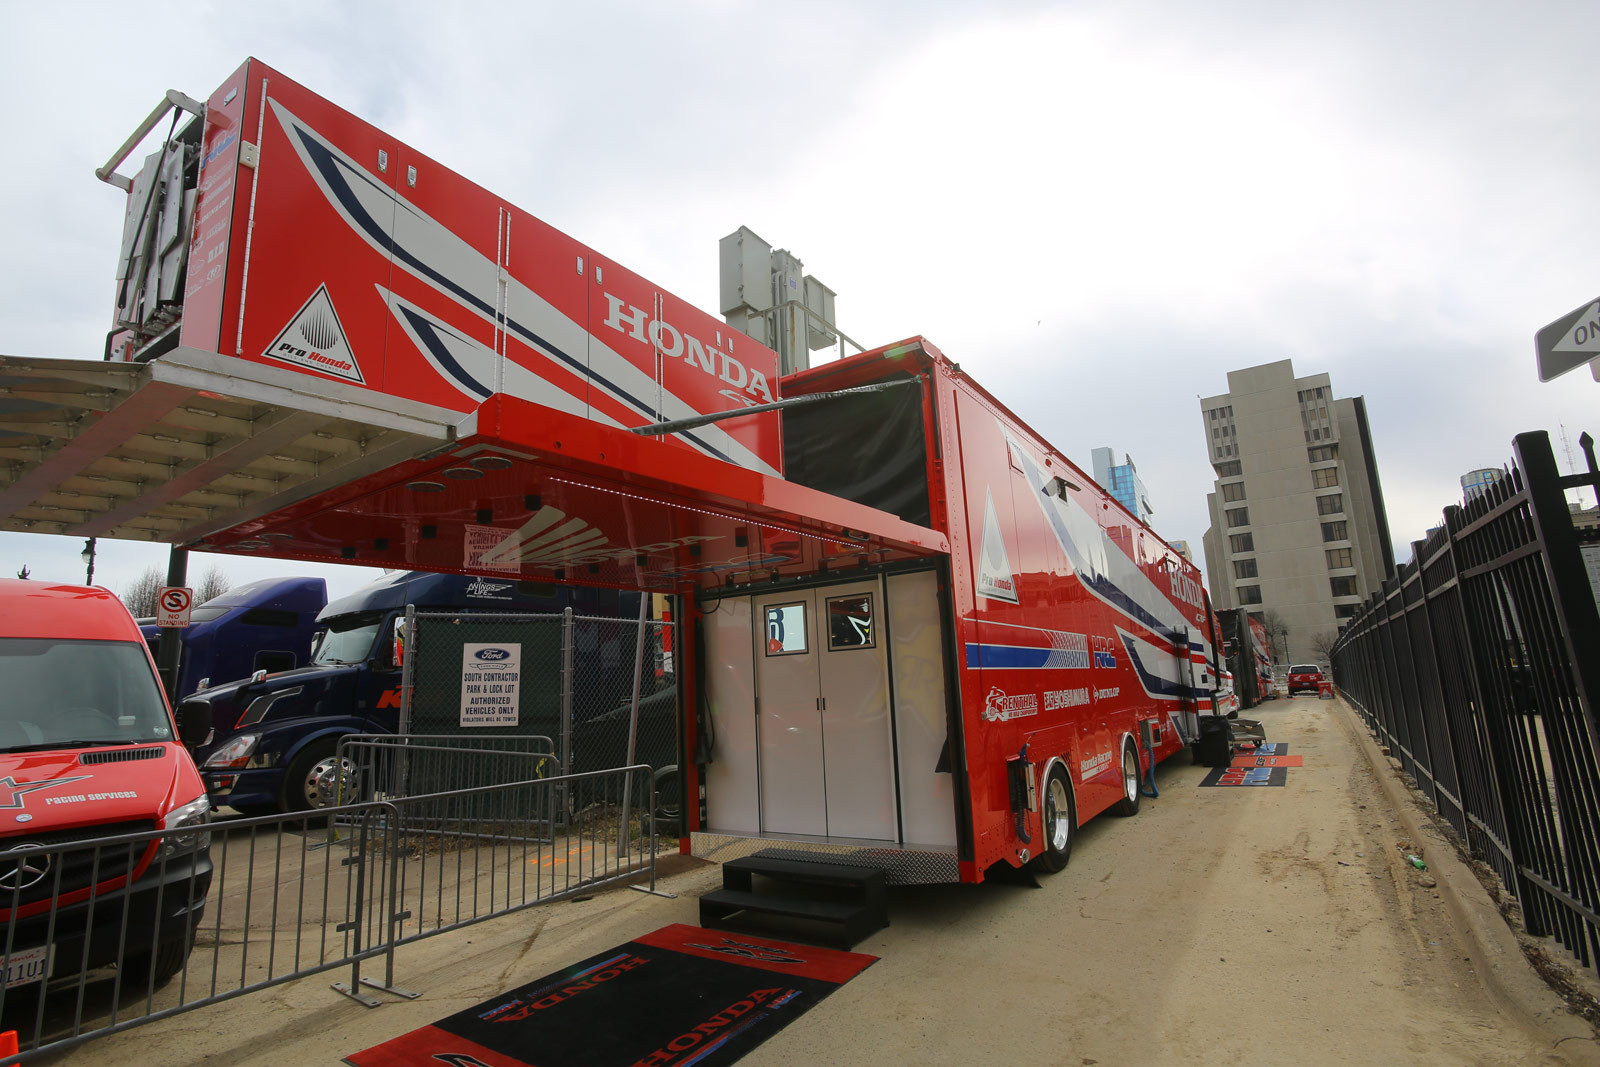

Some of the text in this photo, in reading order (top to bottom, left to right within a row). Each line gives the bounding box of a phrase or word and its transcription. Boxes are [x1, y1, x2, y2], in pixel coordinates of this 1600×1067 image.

[278, 342, 352, 371] Pro Honda
[603, 291, 777, 405] HONDA
[982, 572, 994, 586] Pro
[994, 575, 1012, 591] Honda
[1170, 568, 1206, 612] HONDA
[482, 649, 504, 659] Ford
[1091, 635, 1117, 669] HRC
[464, 672, 519, 682] SOUTH CONTRACTOR
[466, 684, 515, 694] PARK & LOCK LOT
[1002, 687, 1120, 712] RENTHAL YOSHIMURA DUNLOP
[465, 706, 515, 715] VEHICLES ONLY
[470, 696, 511, 705] AUTHORIZED
[45, 790, 138, 805] racing services
[493, 956, 651, 1024] HONDA
[628, 986, 784, 1067] HONDA
